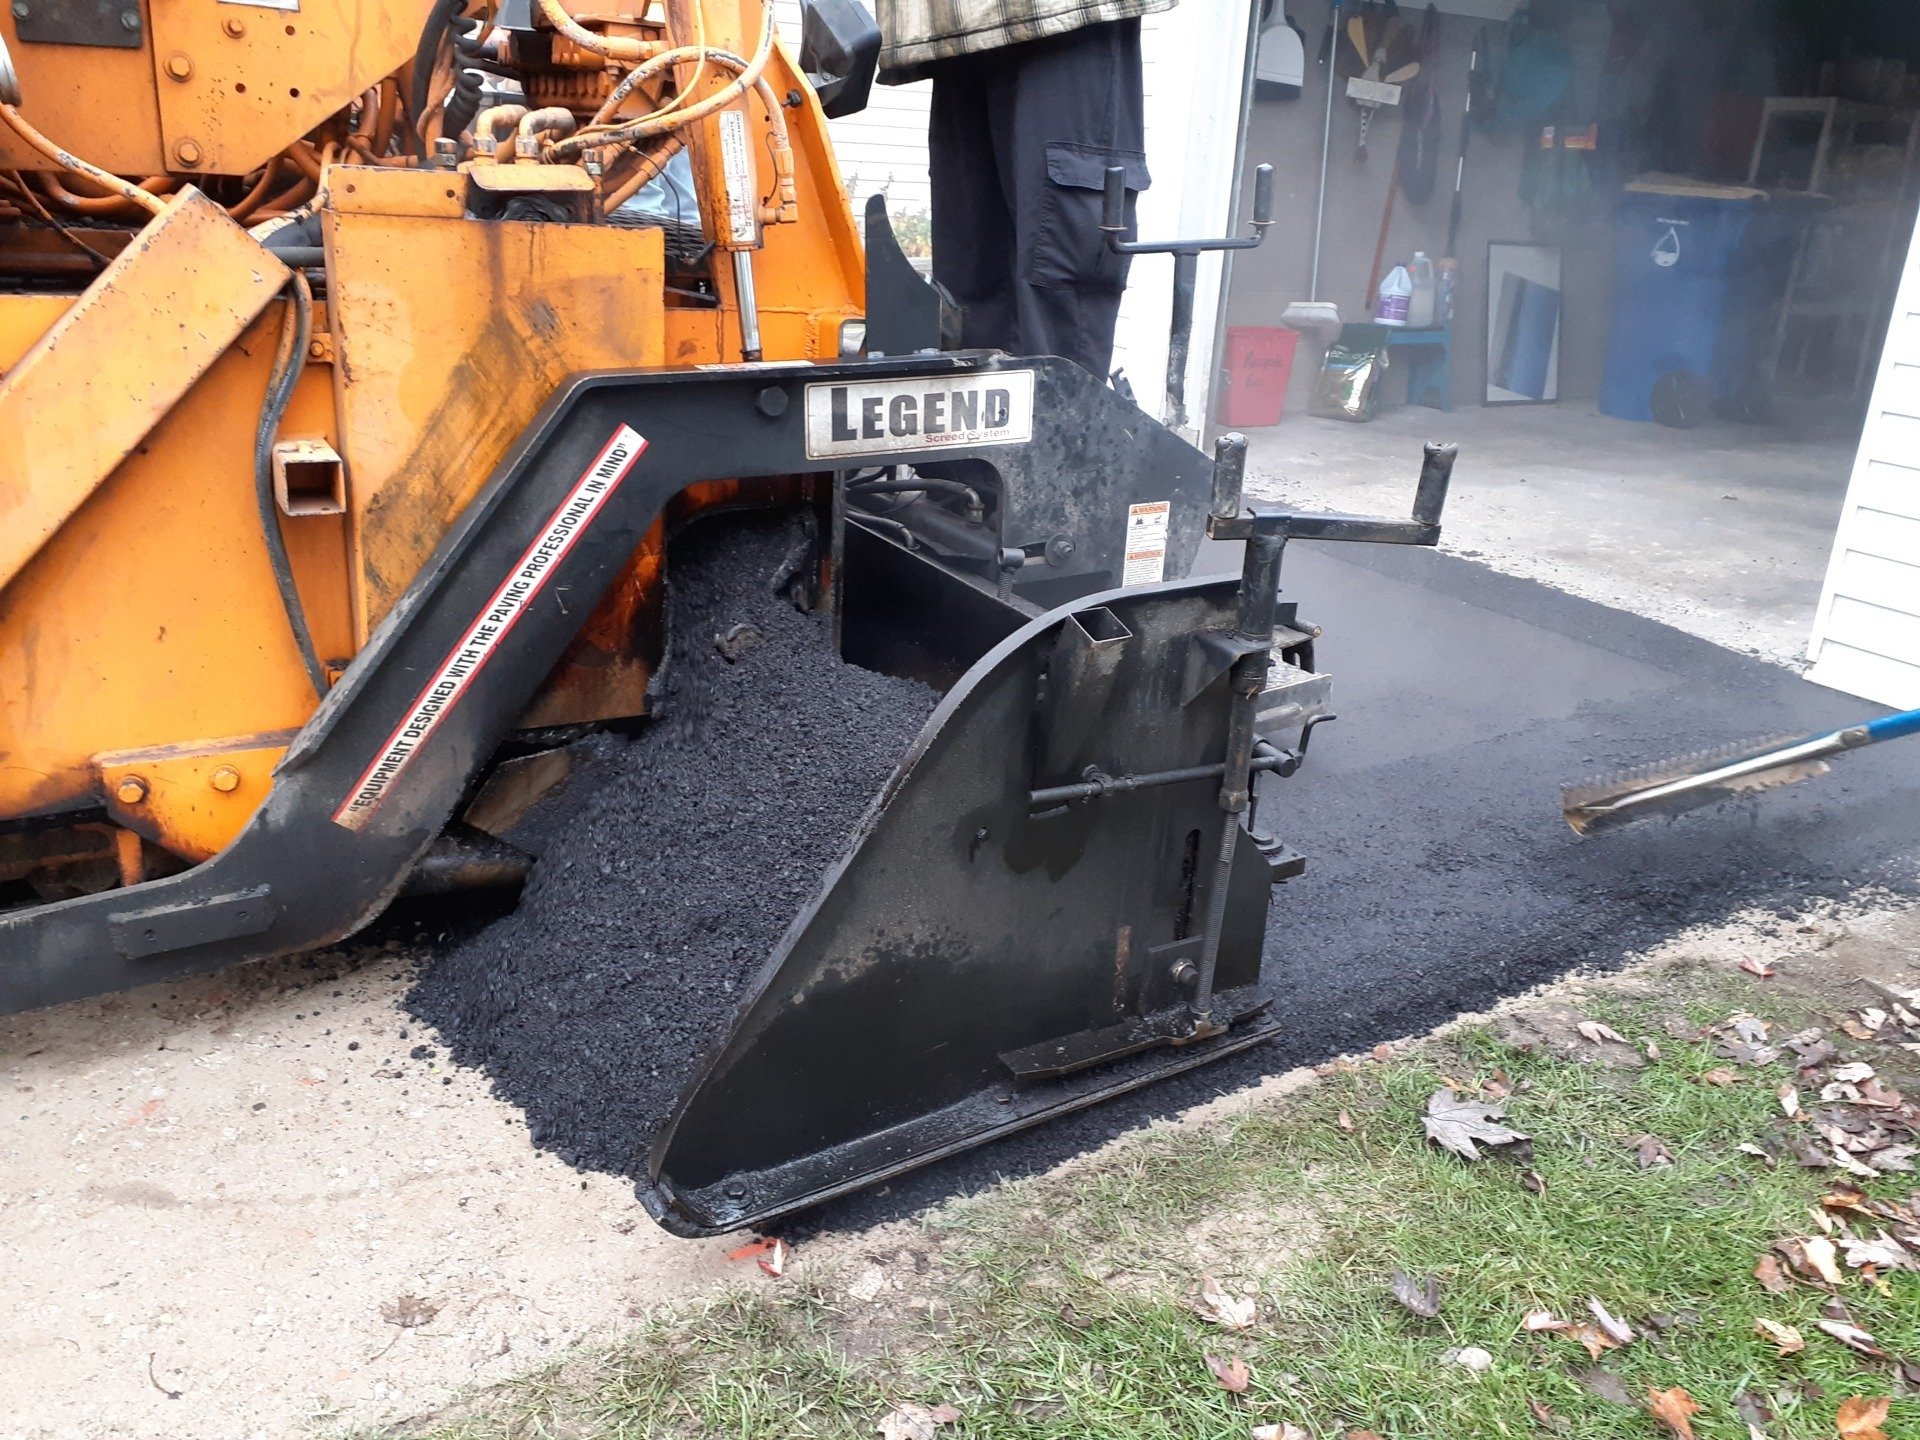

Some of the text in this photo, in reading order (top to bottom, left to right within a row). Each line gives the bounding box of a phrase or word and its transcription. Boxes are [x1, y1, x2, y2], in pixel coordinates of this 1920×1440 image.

[831, 387, 1010, 442] LEGEND
[925, 429, 1010, 443] Screed System
[348, 740, 414, 812] “EQUIPMENT
[404, 681, 457, 739] DESIGNED
[446, 649, 480, 677] WITH
[469, 625, 498, 646] THE
[488, 581, 531, 622] PAVING
[521, 497, 595, 578] PROFESSIONAL
[585, 480, 605, 494] IN
